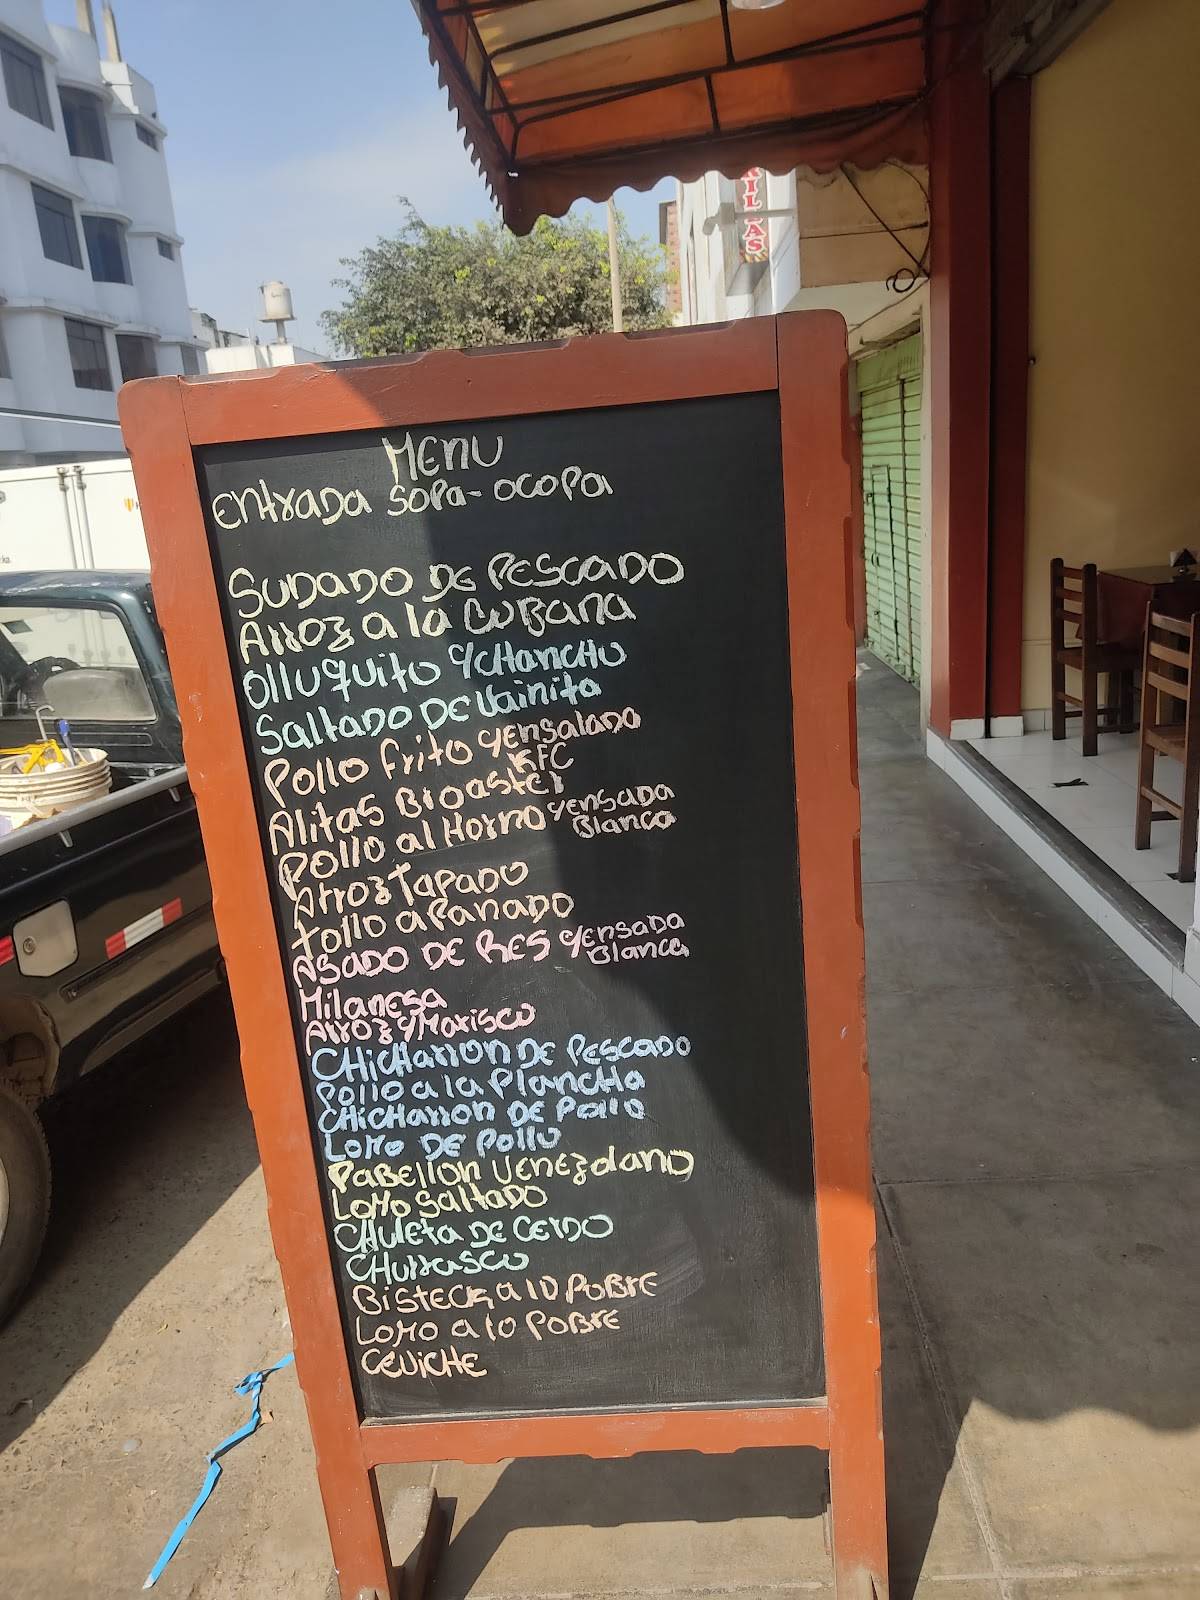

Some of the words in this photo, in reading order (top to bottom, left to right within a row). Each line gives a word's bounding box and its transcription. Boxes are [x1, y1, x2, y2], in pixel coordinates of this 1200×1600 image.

[362, 612, 398, 640] a
[405, 602, 452, 637] la
[507, 741, 574, 774] KFC
[396, 819, 436, 854] al
[421, 937, 465, 970] DE
[516, 1038, 556, 1069] DE
[411, 1080, 439, 1099] a
[441, 1073, 484, 1098] la
[507, 1100, 545, 1128] DE
[418, 1132, 467, 1161] DE
[468, 1220, 507, 1249] DE
[496, 1281, 522, 1302] a
[451, 1318, 480, 1339] a
